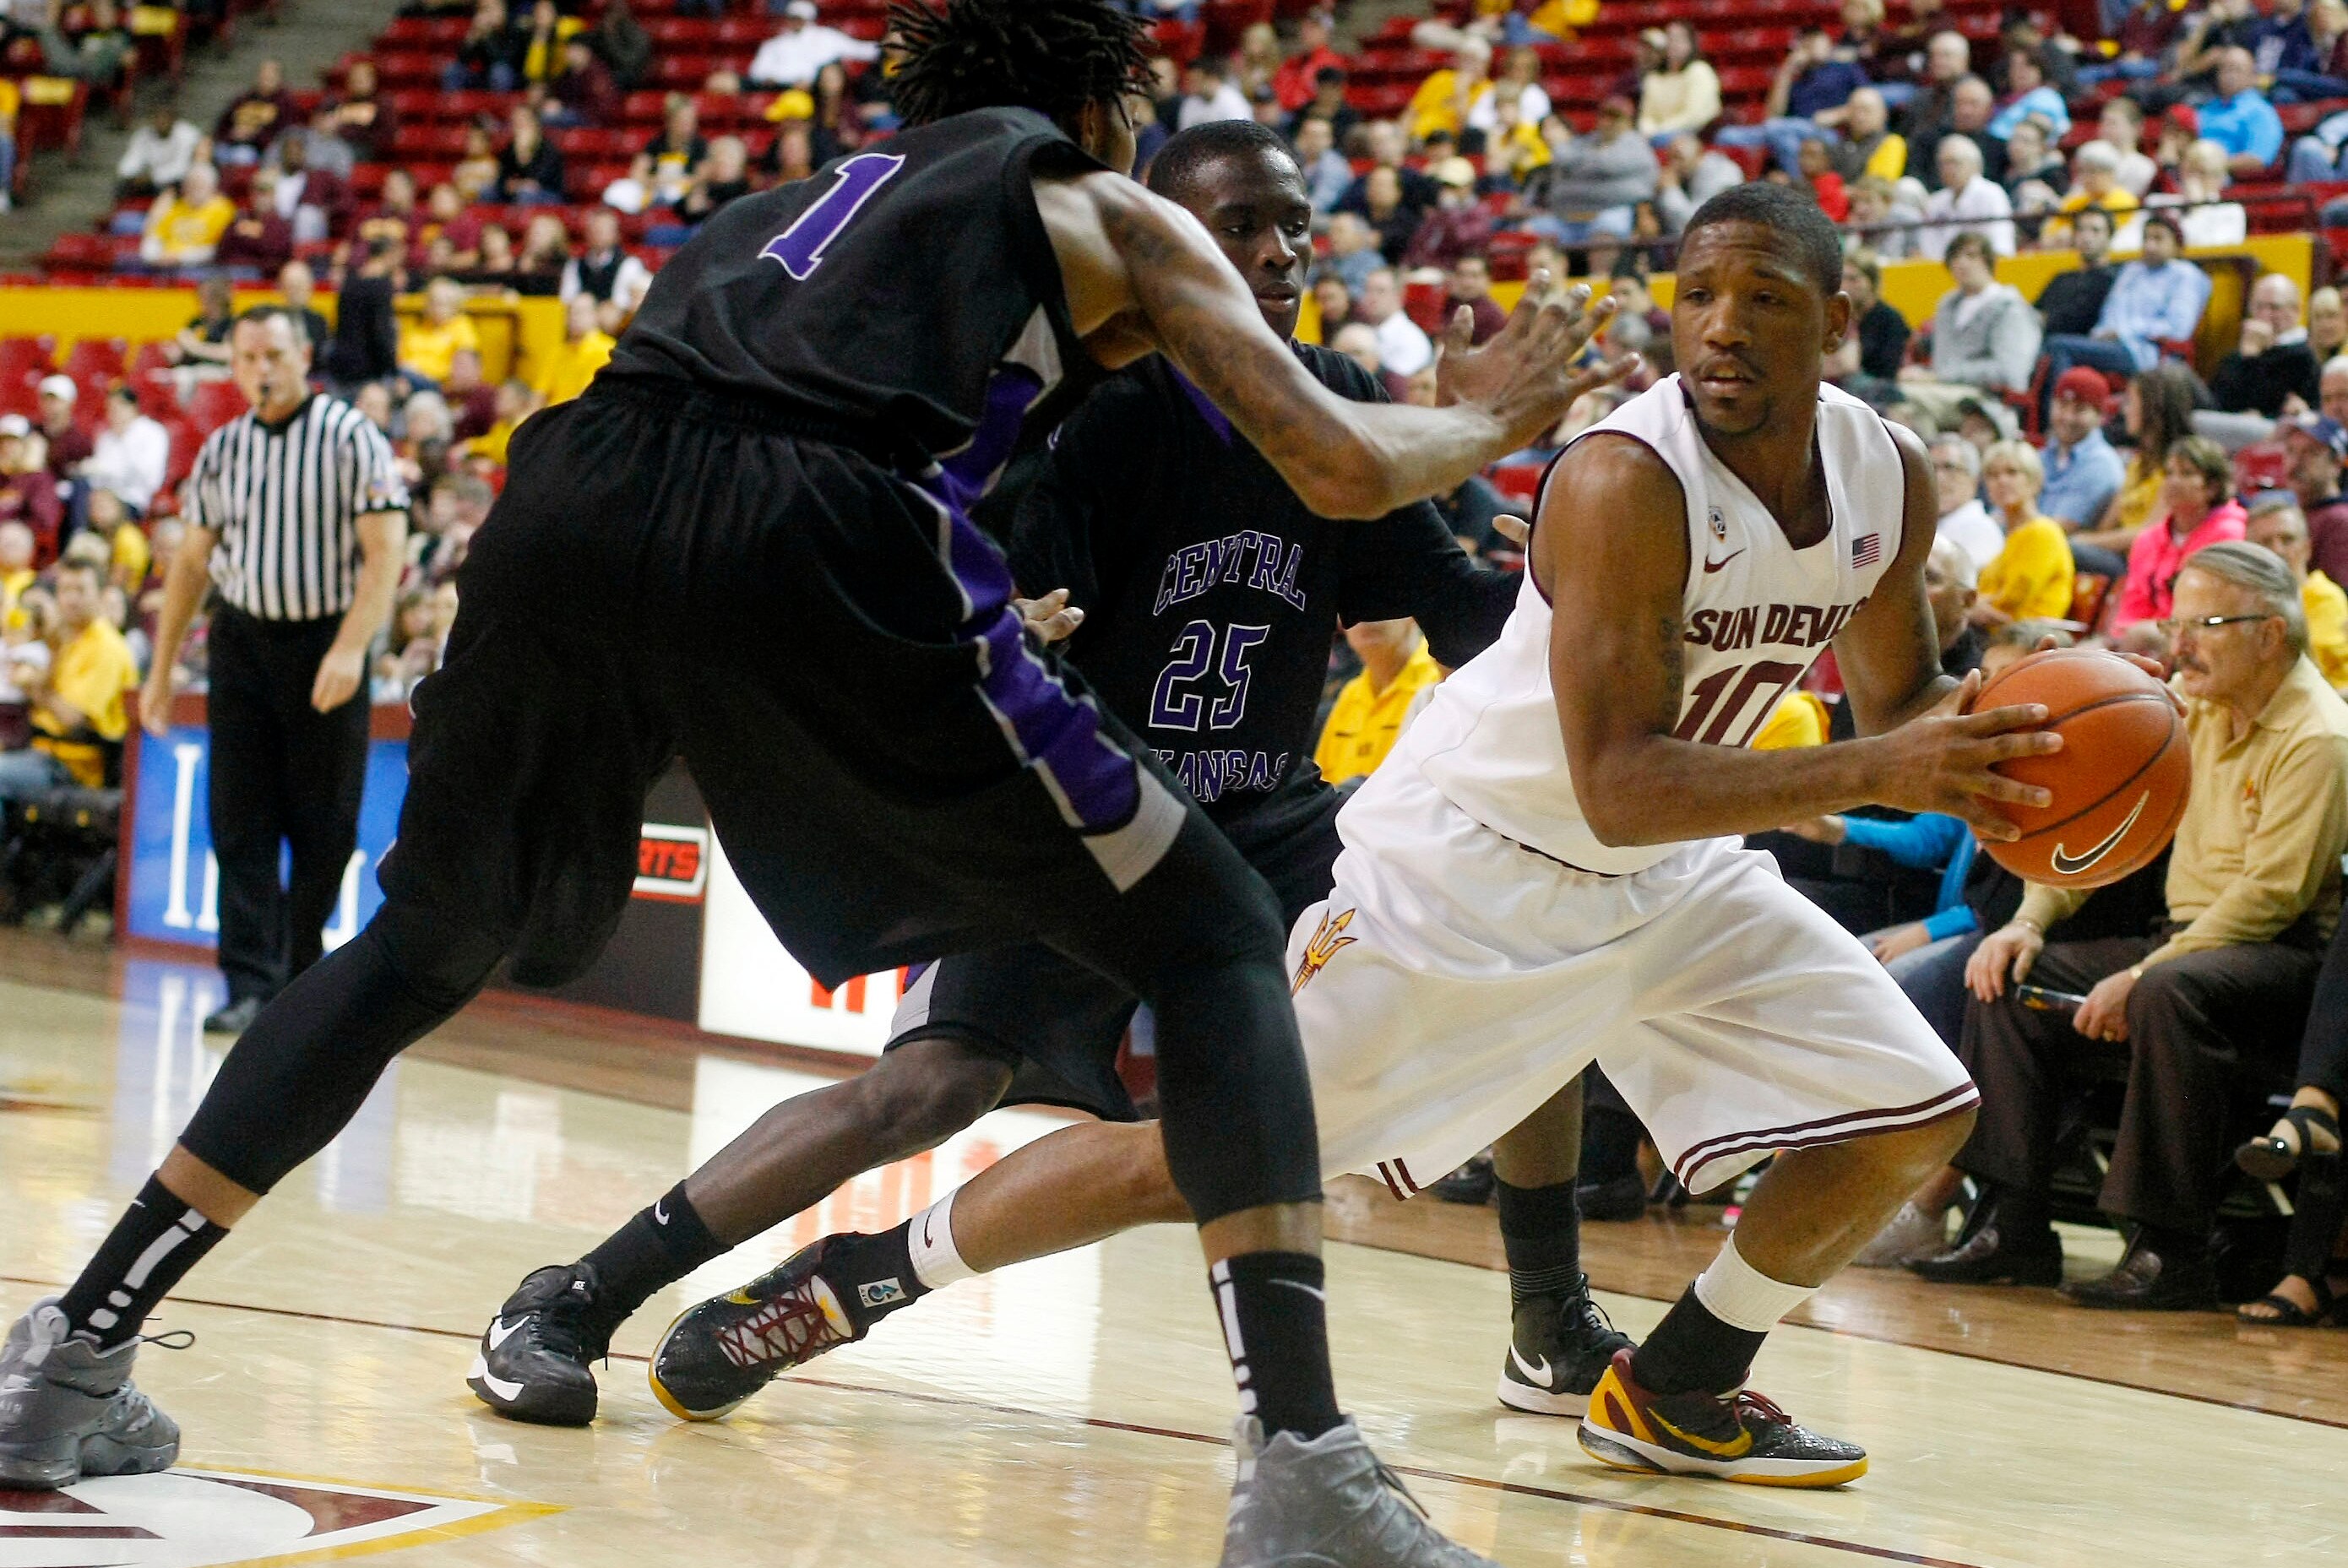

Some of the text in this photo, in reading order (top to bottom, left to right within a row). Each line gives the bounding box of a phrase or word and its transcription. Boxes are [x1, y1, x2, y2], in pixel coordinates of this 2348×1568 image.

[757, 153, 906, 281] 1
[1153, 529, 1306, 616] CENTRAL
[1683, 605, 1760, 652] SUN
[1148, 619, 1271, 732] 25
[1673, 660, 1805, 749] 10
